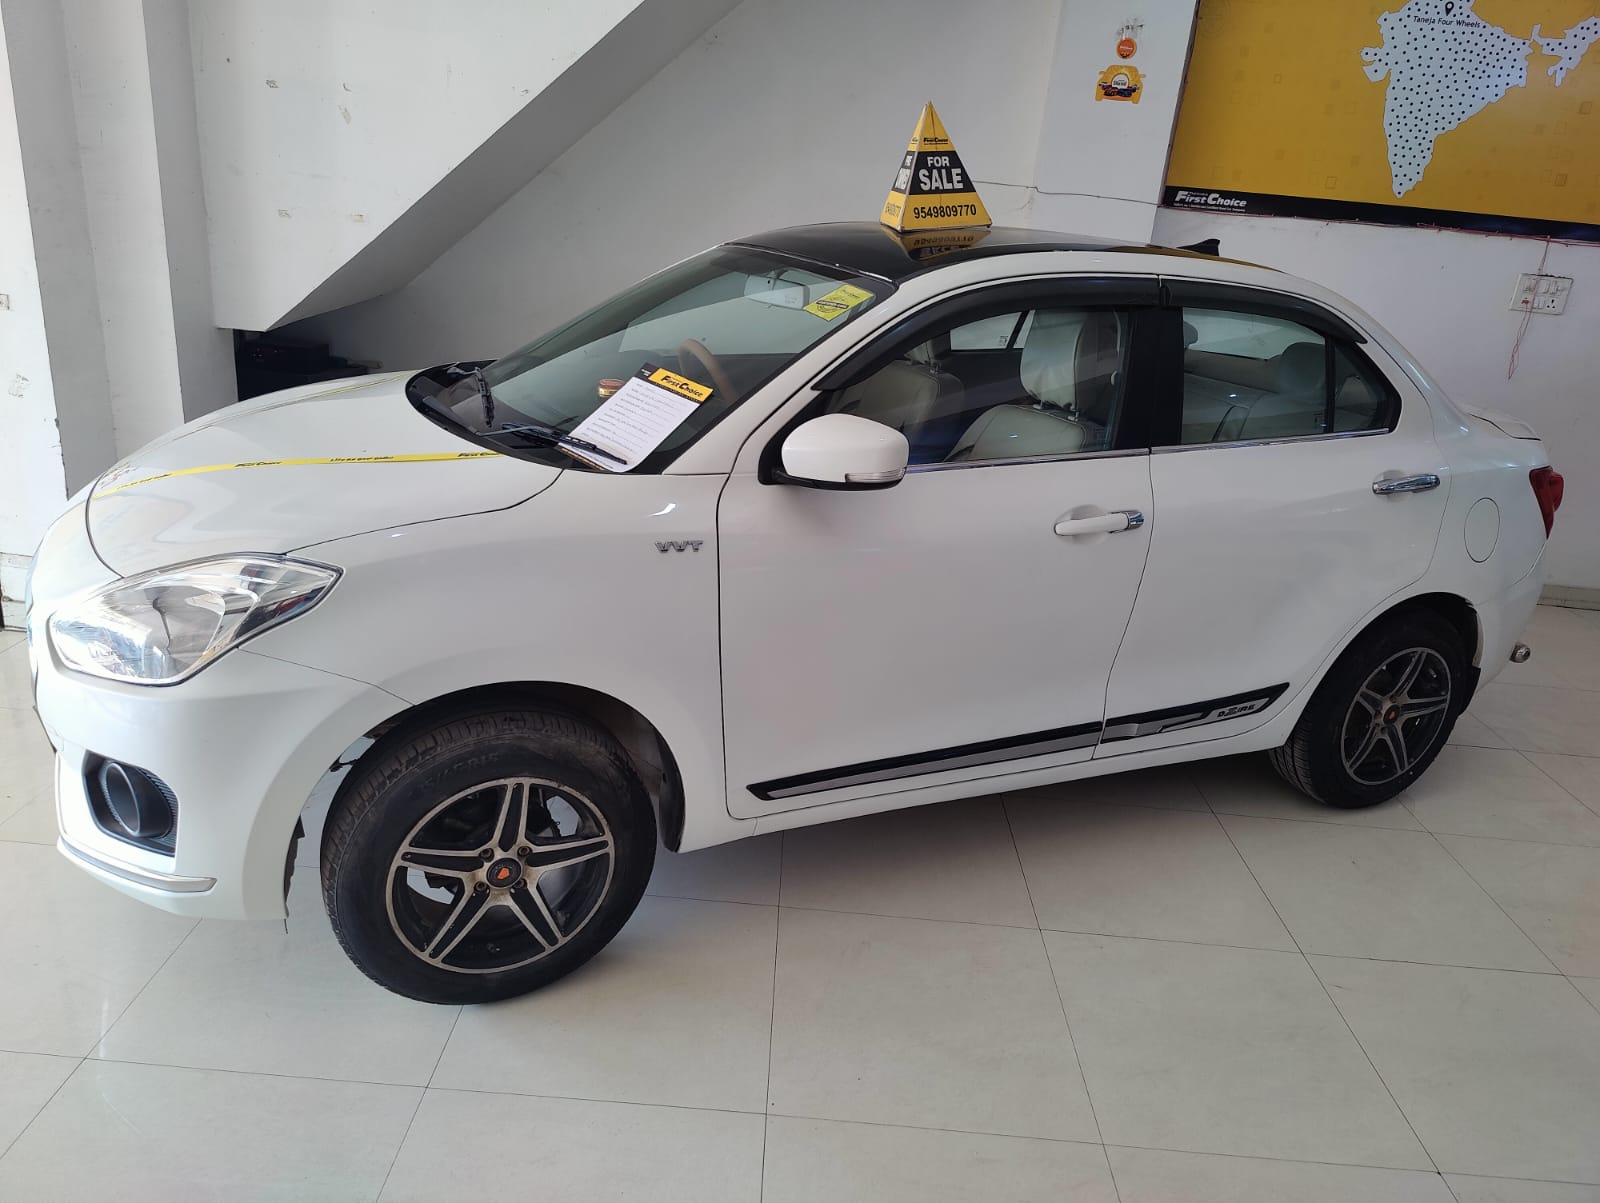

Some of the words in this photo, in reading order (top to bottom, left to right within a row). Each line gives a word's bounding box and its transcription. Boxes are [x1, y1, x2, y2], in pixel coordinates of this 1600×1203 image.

[1413, 15, 1436, 26] Taneja
[1437, 17, 1454, 26] Four
[1456, 19, 1481, 29] Wheels
[926, 156, 950, 168] FOR
[918, 168, 964, 191] SALE
[913, 204, 977, 219] 9549809770
[654, 540, 704, 553] VVT
